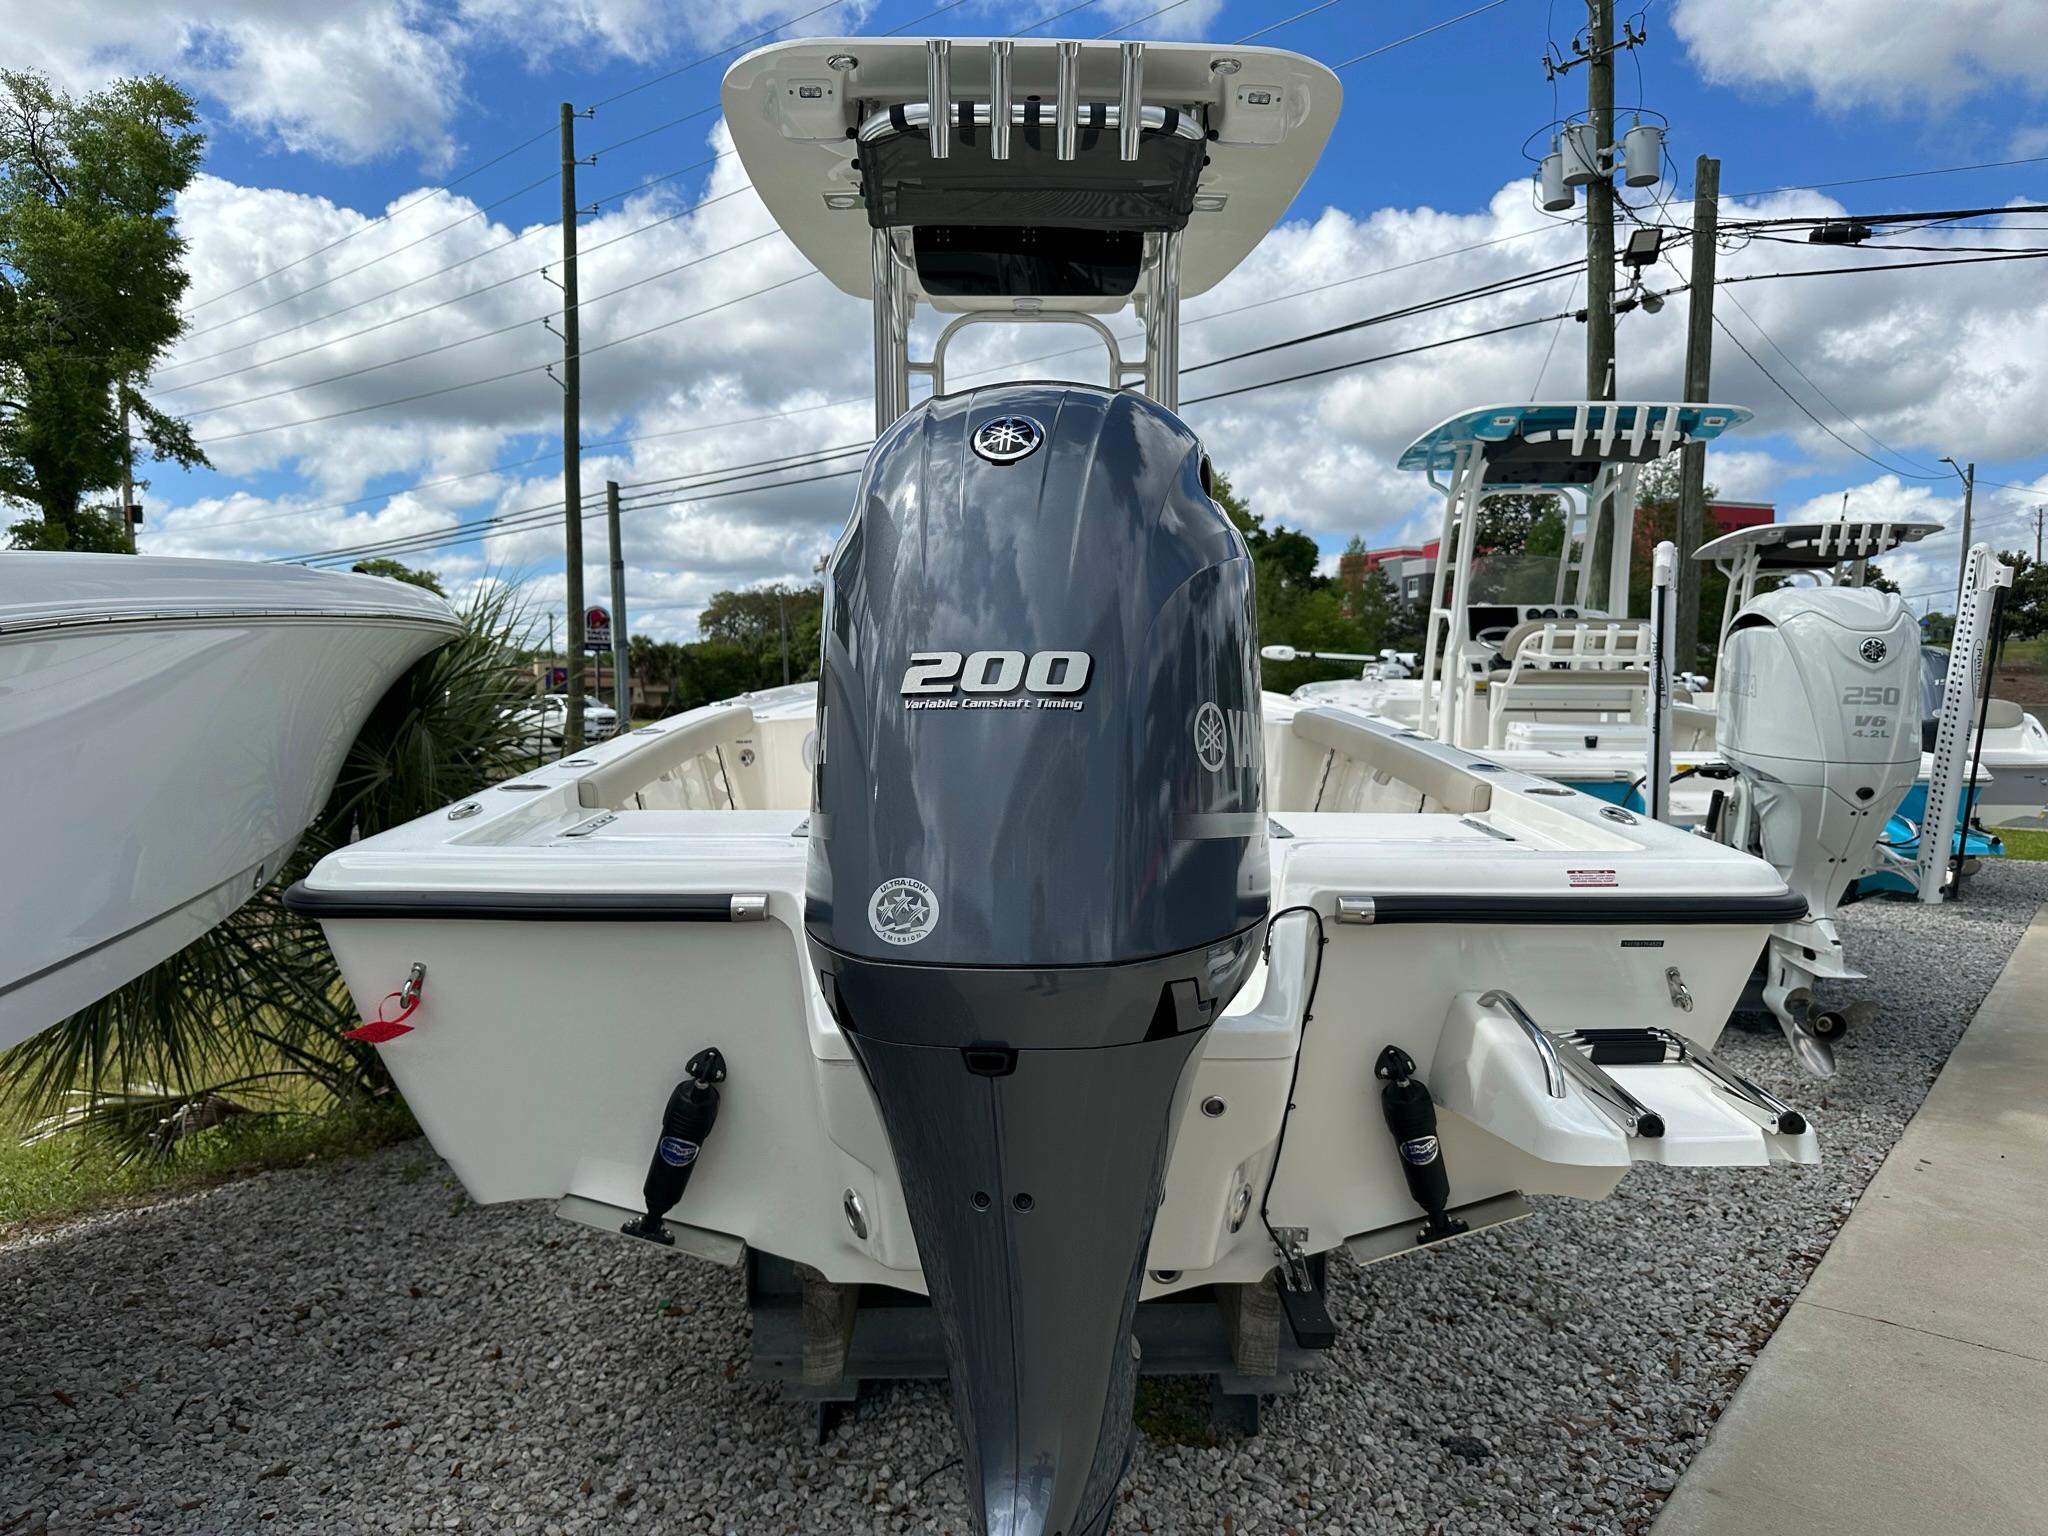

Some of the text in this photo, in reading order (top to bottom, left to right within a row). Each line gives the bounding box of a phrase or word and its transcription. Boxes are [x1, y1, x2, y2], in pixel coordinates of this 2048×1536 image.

[900, 650, 1092, 694] 200
[1843, 687, 1900, 705] 250
[904, 698, 1084, 711] Variable Camshaft Timing
[1855, 715, 1888, 727] V6
[1852, 730, 1890, 738] 4.2L
[882, 933, 922, 943] EMISSION
